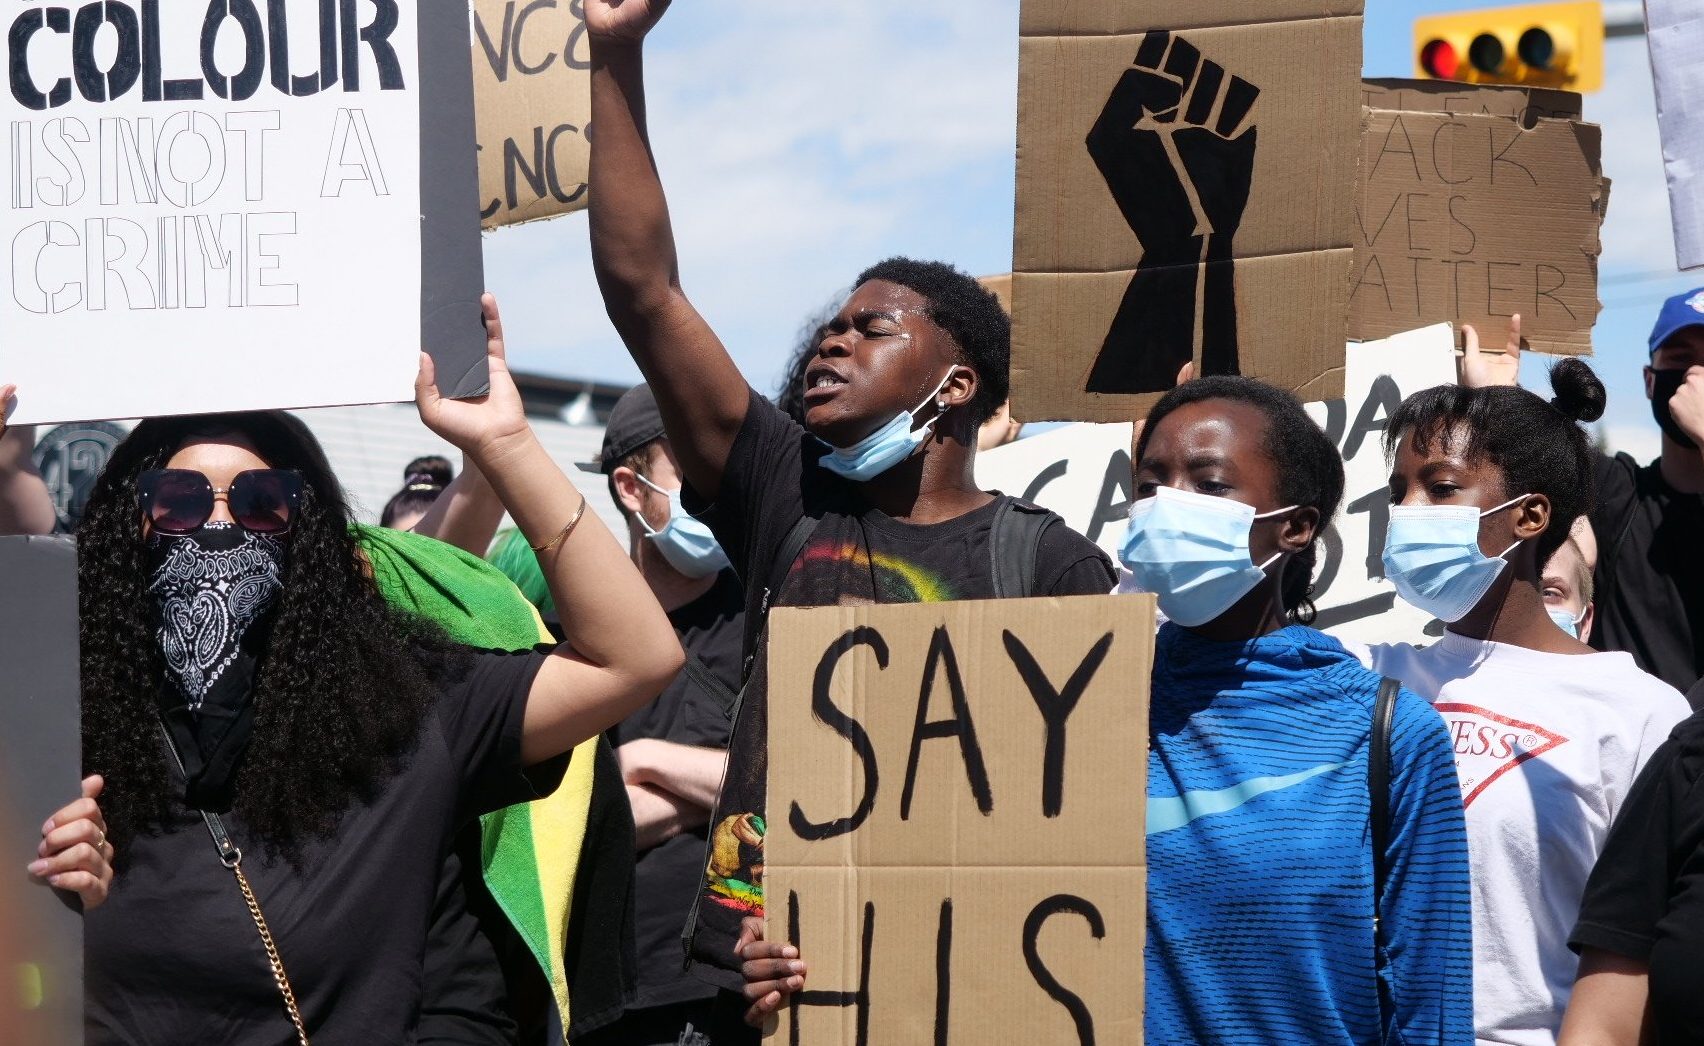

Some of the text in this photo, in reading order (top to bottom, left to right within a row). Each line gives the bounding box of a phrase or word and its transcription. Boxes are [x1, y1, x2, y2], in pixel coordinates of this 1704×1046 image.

[8, 0, 405, 110] COLOUR
[11, 108, 391, 209] IS NOT A
[476, 123, 591, 219] NC
[1368, 114, 1538, 186] ACK
[12, 212, 299, 314] CRIME
[788, 622, 1114, 841] SAY
[788, 889, 1105, 1046] HIS
